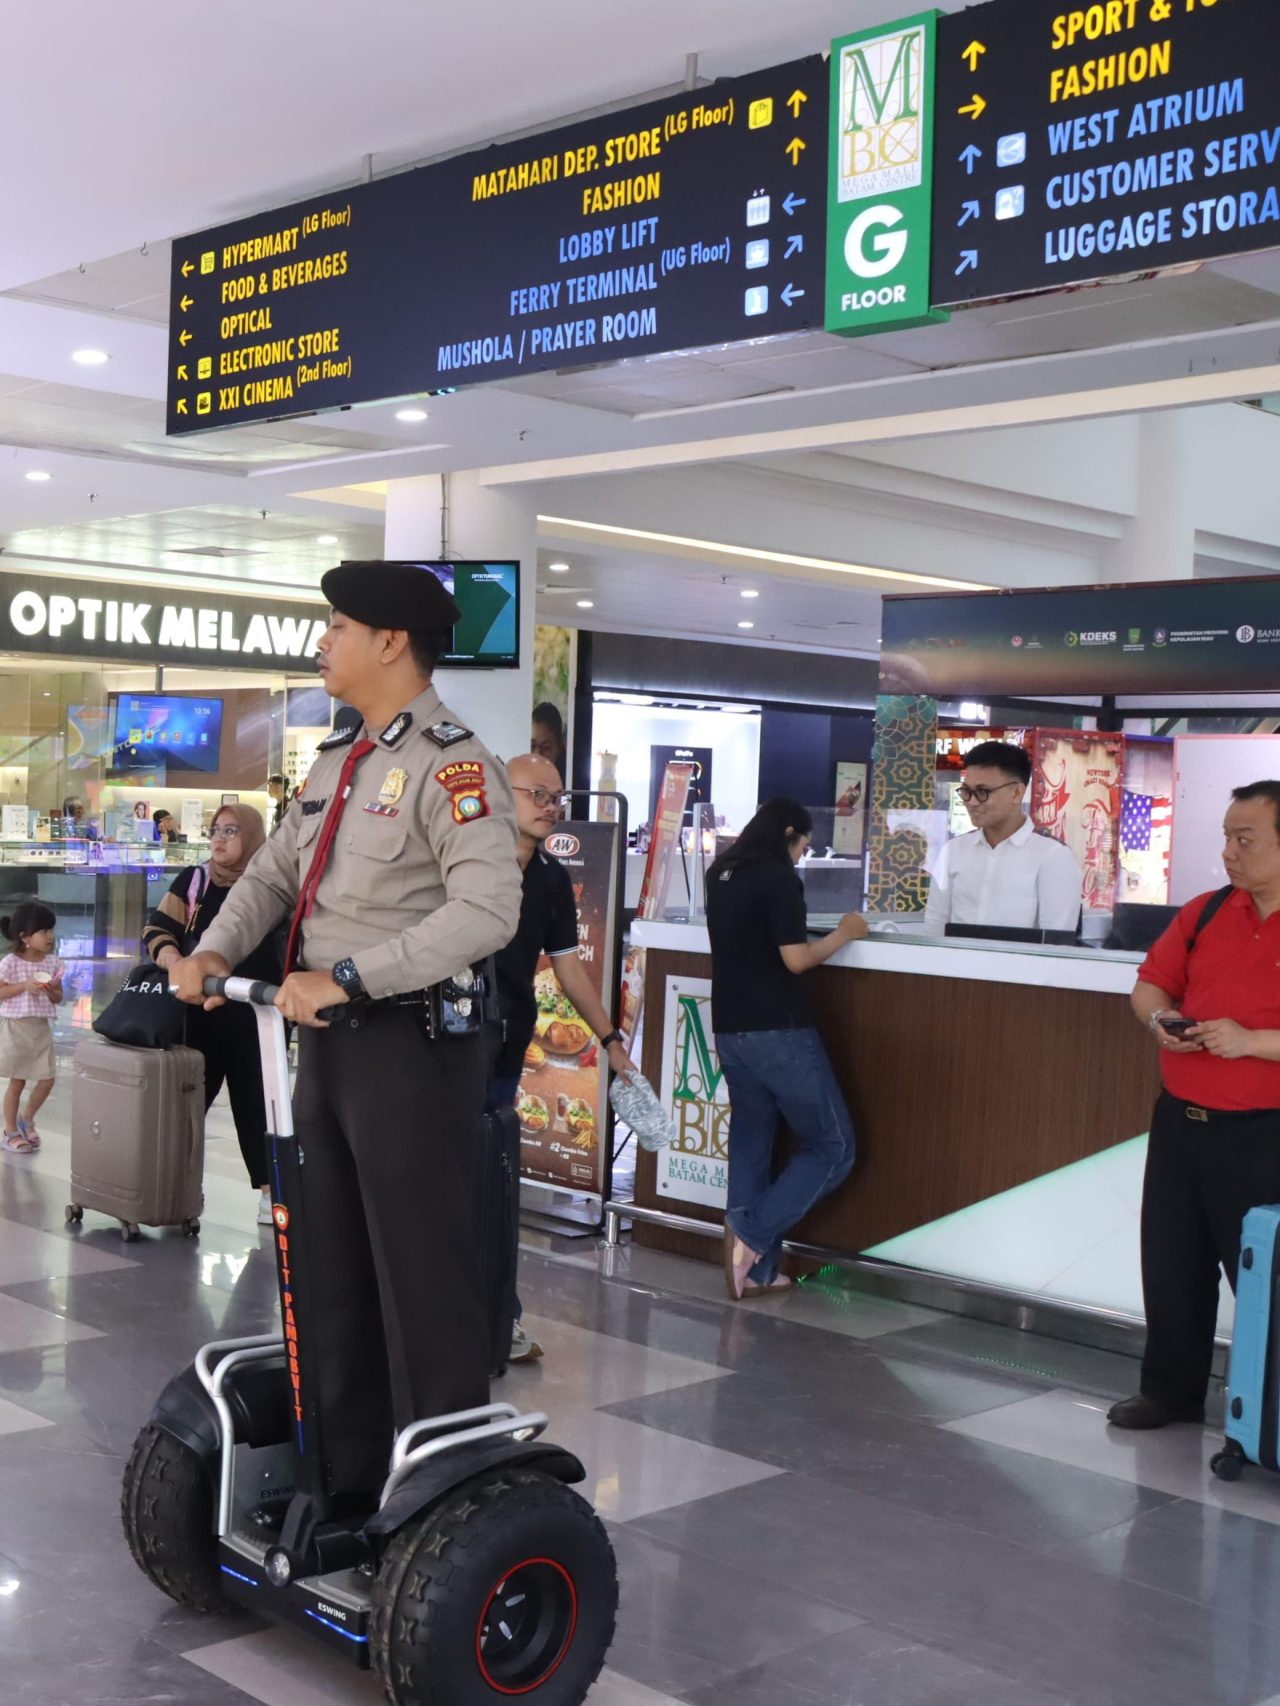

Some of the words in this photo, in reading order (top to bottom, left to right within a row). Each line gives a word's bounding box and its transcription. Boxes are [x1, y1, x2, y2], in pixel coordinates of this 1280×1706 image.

[1051, 0, 1139, 50] SPORT
[1050, 40, 1171, 103] FASHION
[1047, 109, 1119, 156] WEST
[1127, 77, 1244, 139] ATRIUM
[472, 155, 558, 202] MATAHARI
[564, 145, 599, 177] DEP.
[605, 127, 661, 167] STORE
[664, 111, 687, 142] (LG
[692, 98, 734, 130] Floor)
[582, 171, 661, 215] FASHION
[842, 173, 877, 188] MEGA
[882, 164, 916, 180] MALL
[842, 183, 876, 197] BATAM
[1046, 148, 1194, 210] CUSTOMER
[223, 226, 299, 269] HYPERMART
[302, 216, 319, 238] (LG
[321, 204, 351, 228] Floor)
[559, 226, 616, 264] LOBBY
[621, 216, 659, 250] LIFT
[844, 204, 908, 279] G
[1045, 207, 1172, 264] LUGGAGE
[222, 275, 255, 304] FOOD
[258, 272, 268, 294] &
[272, 251, 347, 291] BEVERAGES
[510, 281, 561, 316] FERRY
[566, 262, 657, 305] TERMINAL
[660, 249, 686, 276] (UG
[690, 236, 731, 266] Floor)
[841, 285, 906, 312] FLOOR
[221, 307, 272, 339] OPTICAL
[437, 334, 513, 372] MUSHOLA
[531, 318, 596, 355] PRAYER
[602, 307, 657, 343] ROOM
[220, 337, 294, 375] ELECTRONIC
[298, 328, 339, 358] STORE
[219, 386, 240, 410] XXI
[243, 375, 293, 406] CINEMA
[297, 362, 319, 388] (2nd
[322, 356, 352, 379] Floor)
[10, 590, 151, 644] OPTIK
[438, 763, 480, 780] POLDA
[669, 1156, 708, 1175] MEGA
[669, 1167, 706, 1186] BATAM
[279, 1234, 290, 1285] DIT
[284, 1292, 302, 1422] PAMOBVIT
[261, 1485, 297, 1499] ESWIN
[318, 1602, 347, 1621] ESWING
